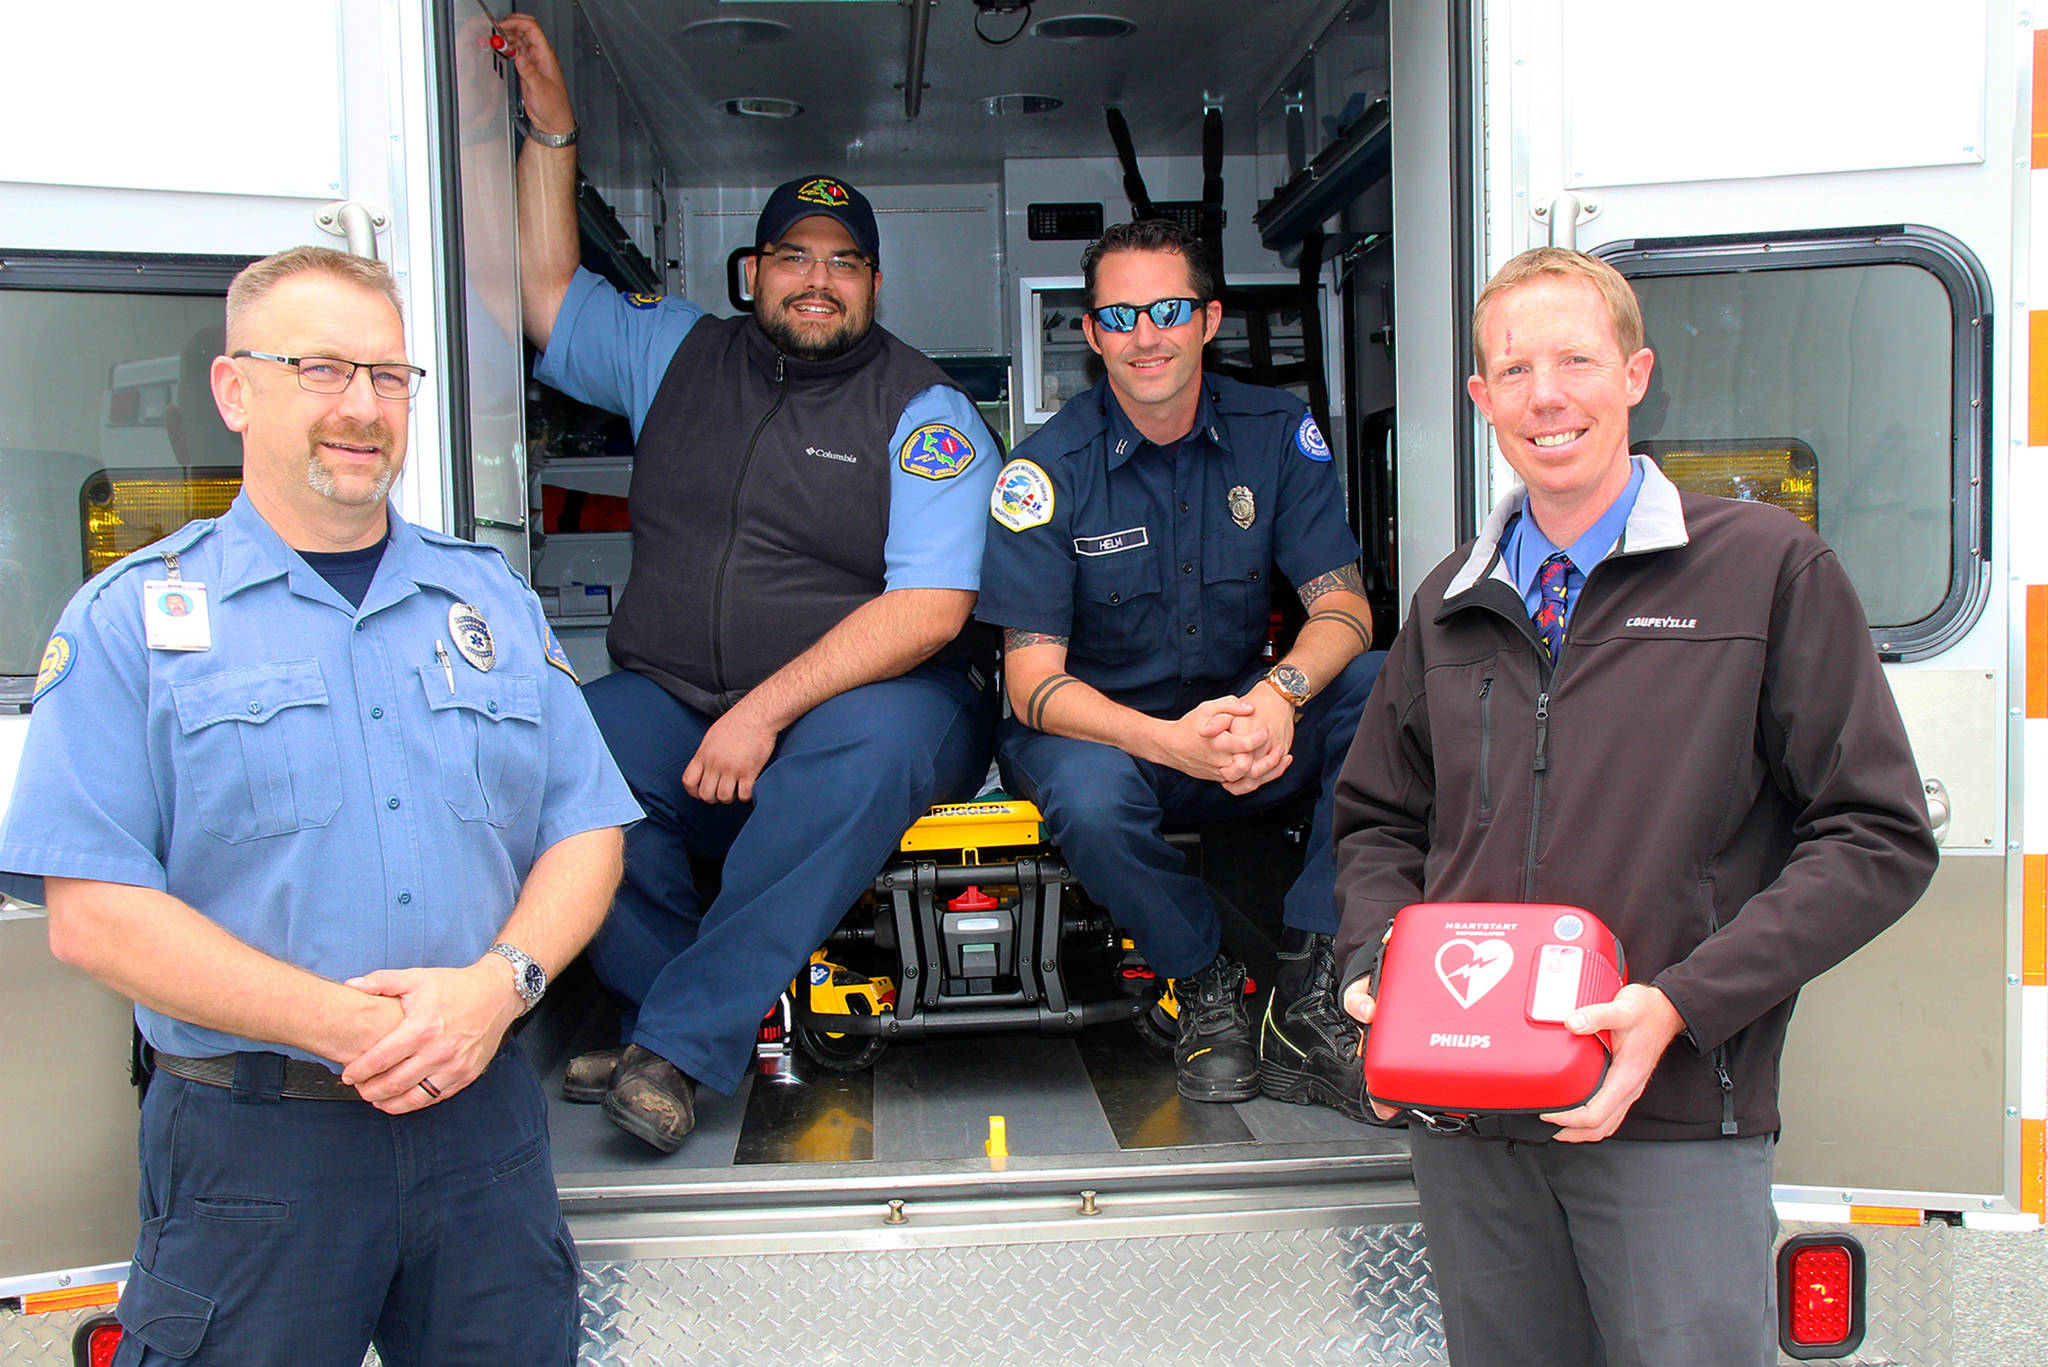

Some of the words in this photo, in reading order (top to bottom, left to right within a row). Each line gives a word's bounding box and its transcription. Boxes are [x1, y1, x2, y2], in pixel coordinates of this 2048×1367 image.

[815, 449, 857, 463] Columbia
[1099, 536, 1123, 551] HELM
[1625, 616, 1697, 629] COUPEVILLE
[1445, 922, 1518, 930] HEARTSTART
[1429, 1033, 1491, 1049] PHILIPS
